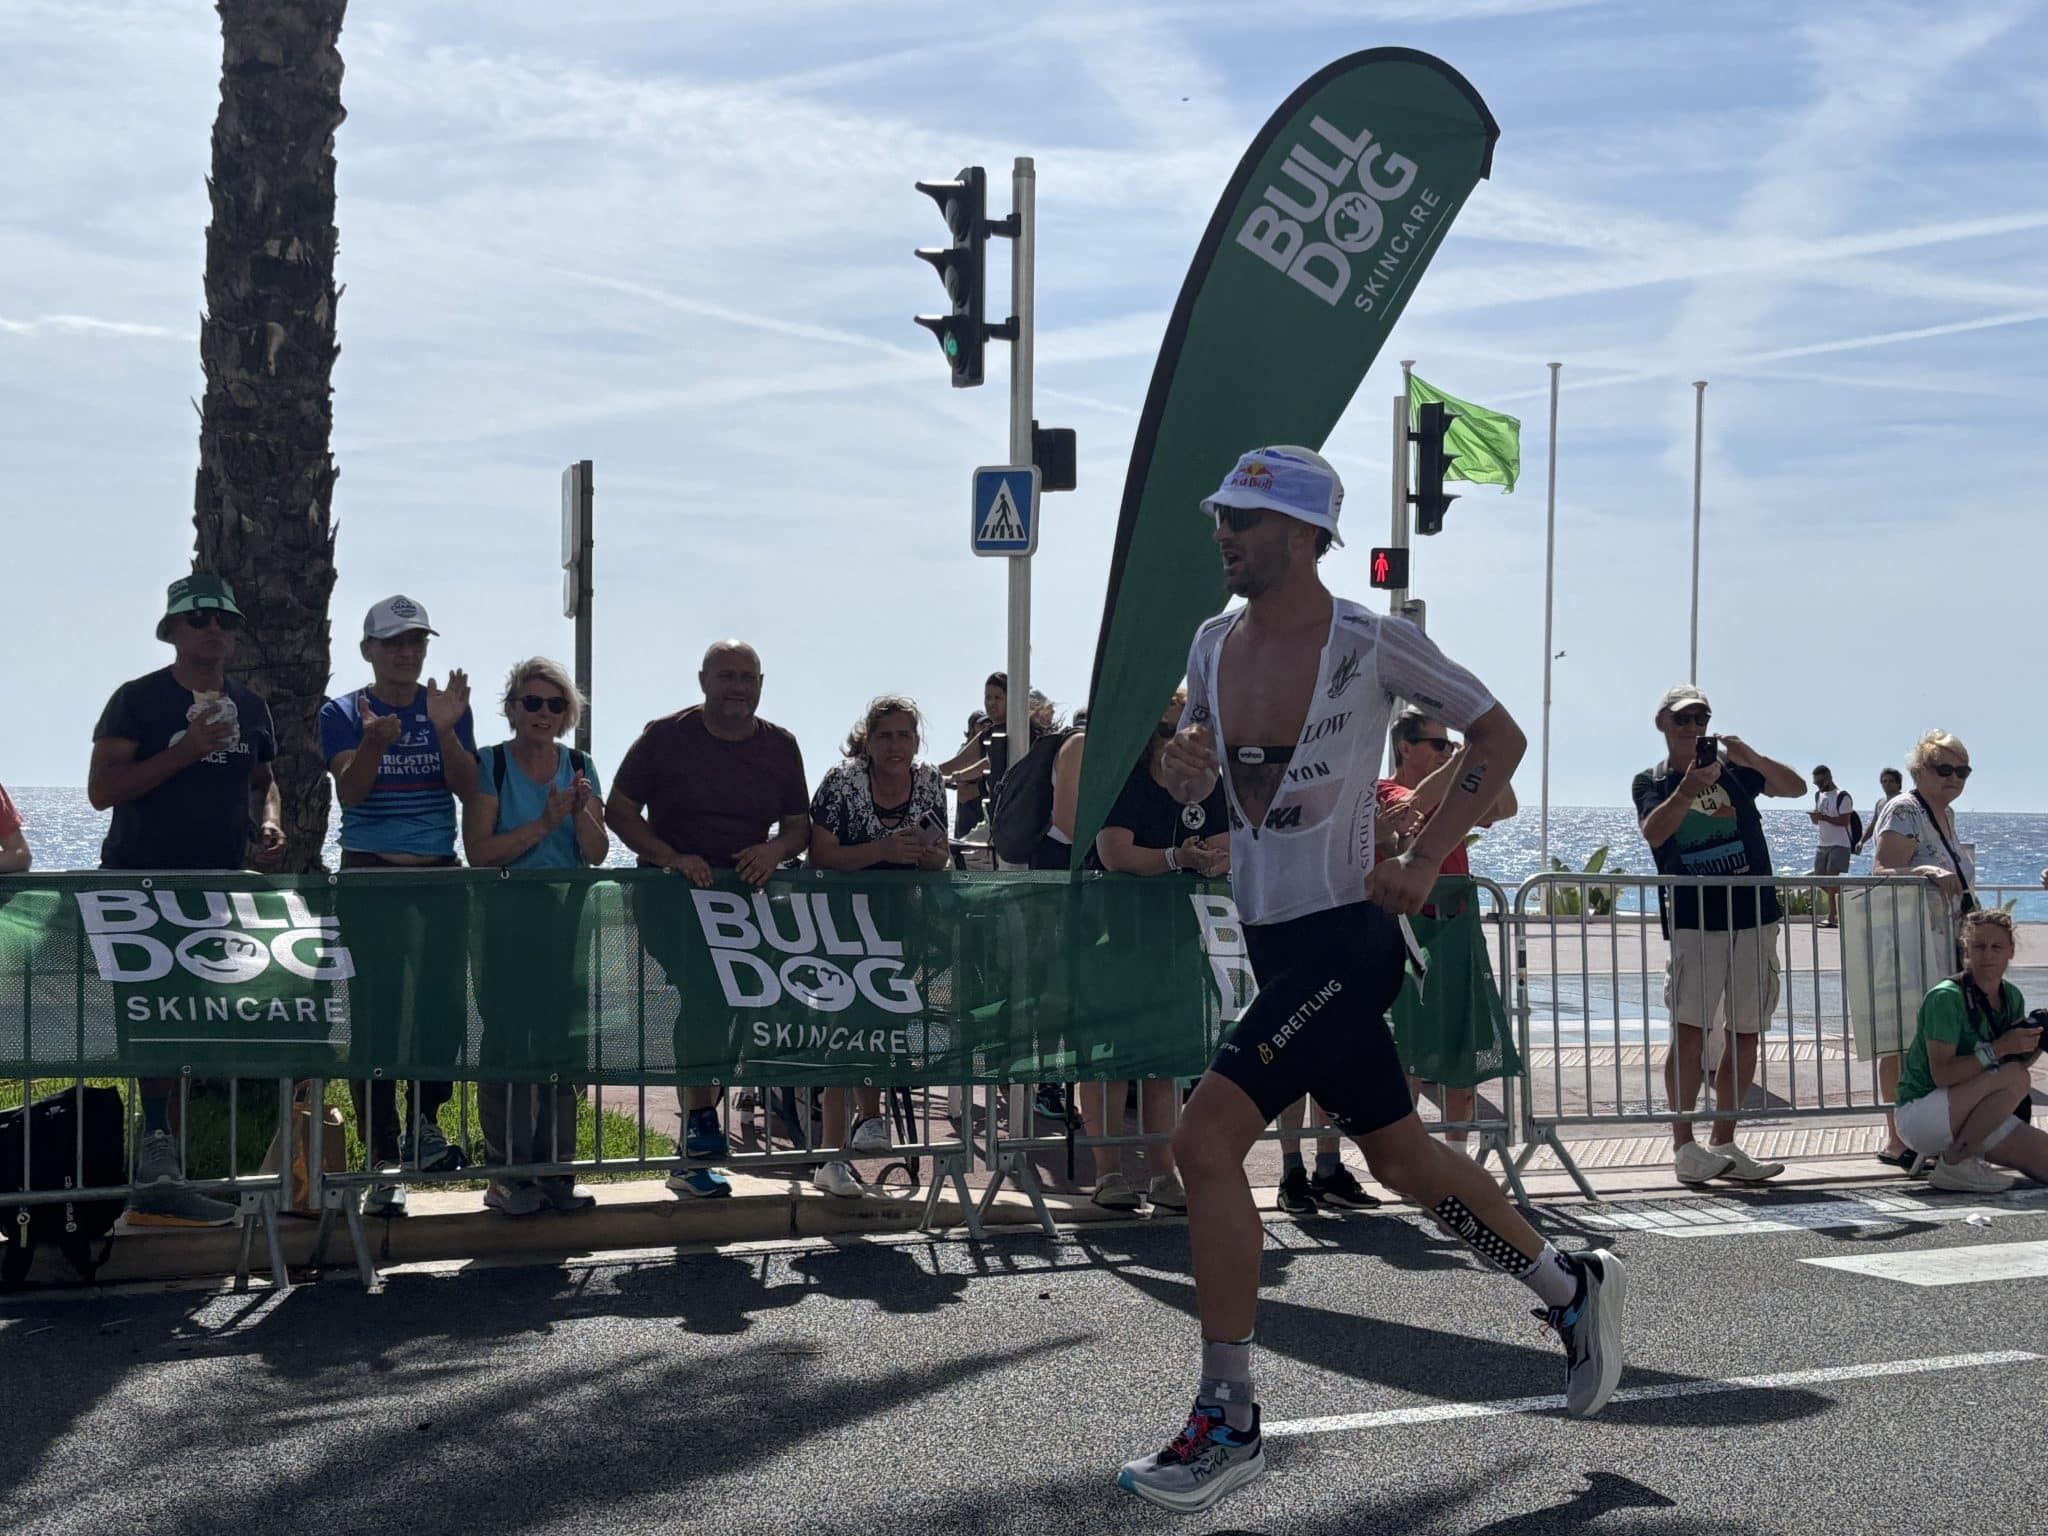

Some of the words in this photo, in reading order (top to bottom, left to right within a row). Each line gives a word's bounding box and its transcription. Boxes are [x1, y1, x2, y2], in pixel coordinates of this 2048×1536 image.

[1235, 114, 1373, 273] BULL
[1286, 142, 1418, 307] DOG
[1354, 187, 1441, 312] SKINCARE
[74, 889, 340, 933] BULL
[690, 889, 903, 956] BULL
[89, 928, 356, 983] DOG
[710, 948, 924, 1013] DOG
[126, 996, 347, 1023] SKINCARE
[752, 1021, 907, 1054] SKINCARE
[1272, 979, 1343, 1049] BREITLING
